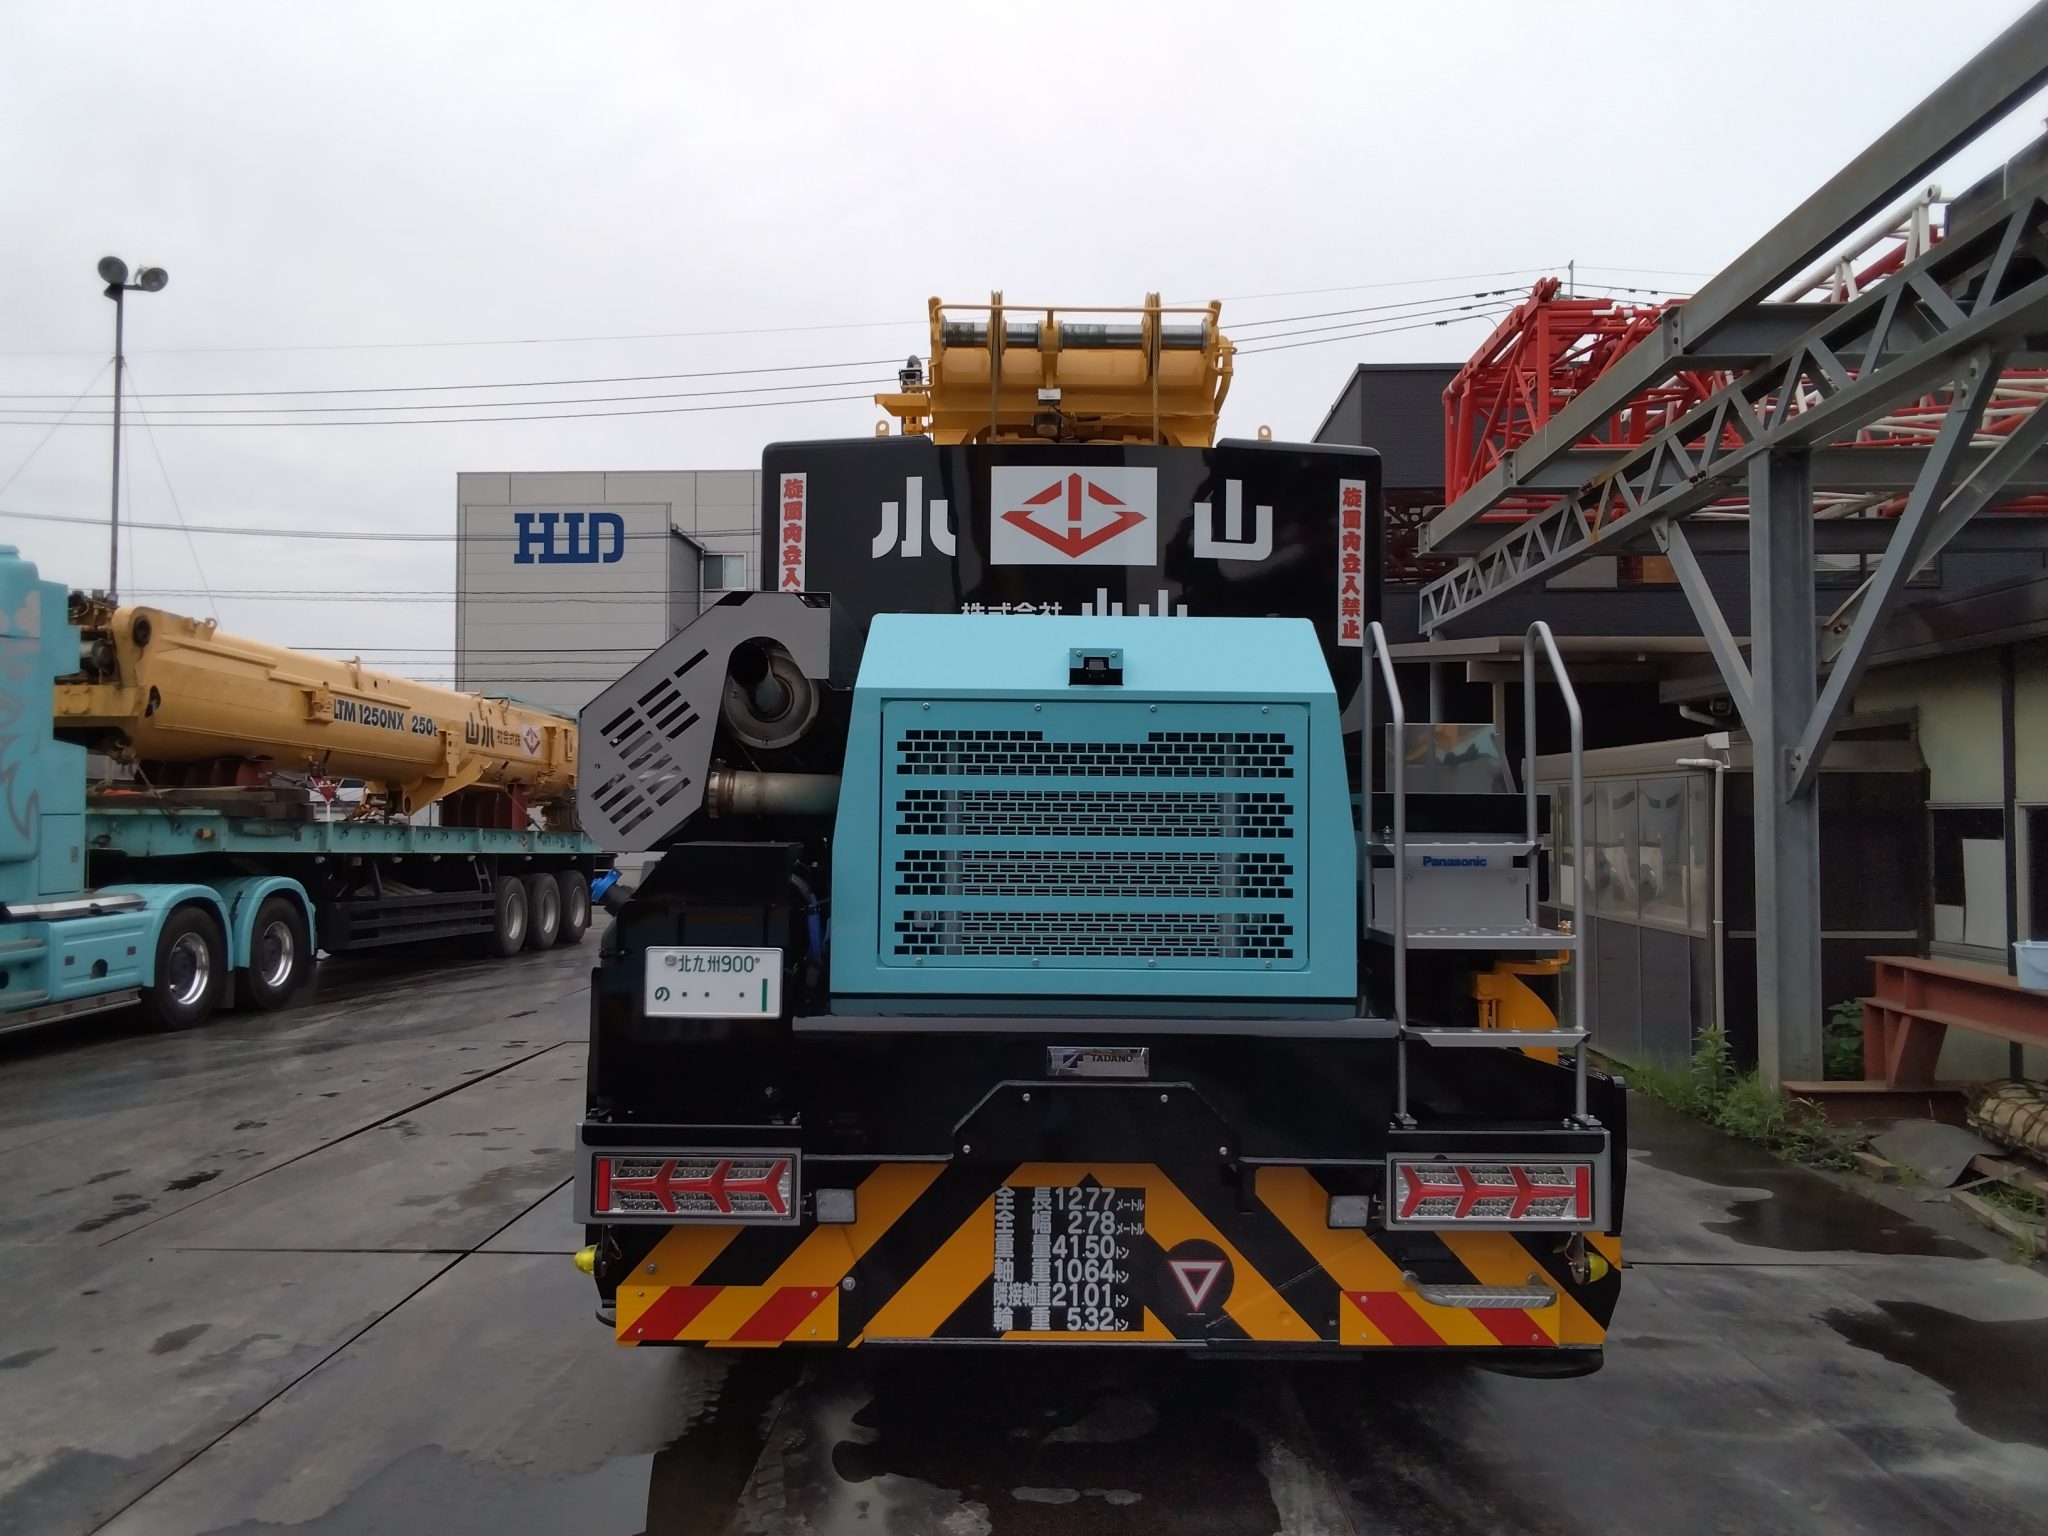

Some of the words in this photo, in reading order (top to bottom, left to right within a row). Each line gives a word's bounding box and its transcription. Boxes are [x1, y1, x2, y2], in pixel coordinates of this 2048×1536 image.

[782, 479, 804, 592] 旋回内立入
[872, 476, 956, 558] 小
[1194, 479, 1273, 561] 山
[1342, 487, 1362, 639] 旋回内立入禁止
[333, 699, 356, 722] LTM
[359, 704, 405, 731] 1250NX
[1422, 855, 1488, 868] Panasonic
[1091, 1053, 1134, 1063] TADANO
